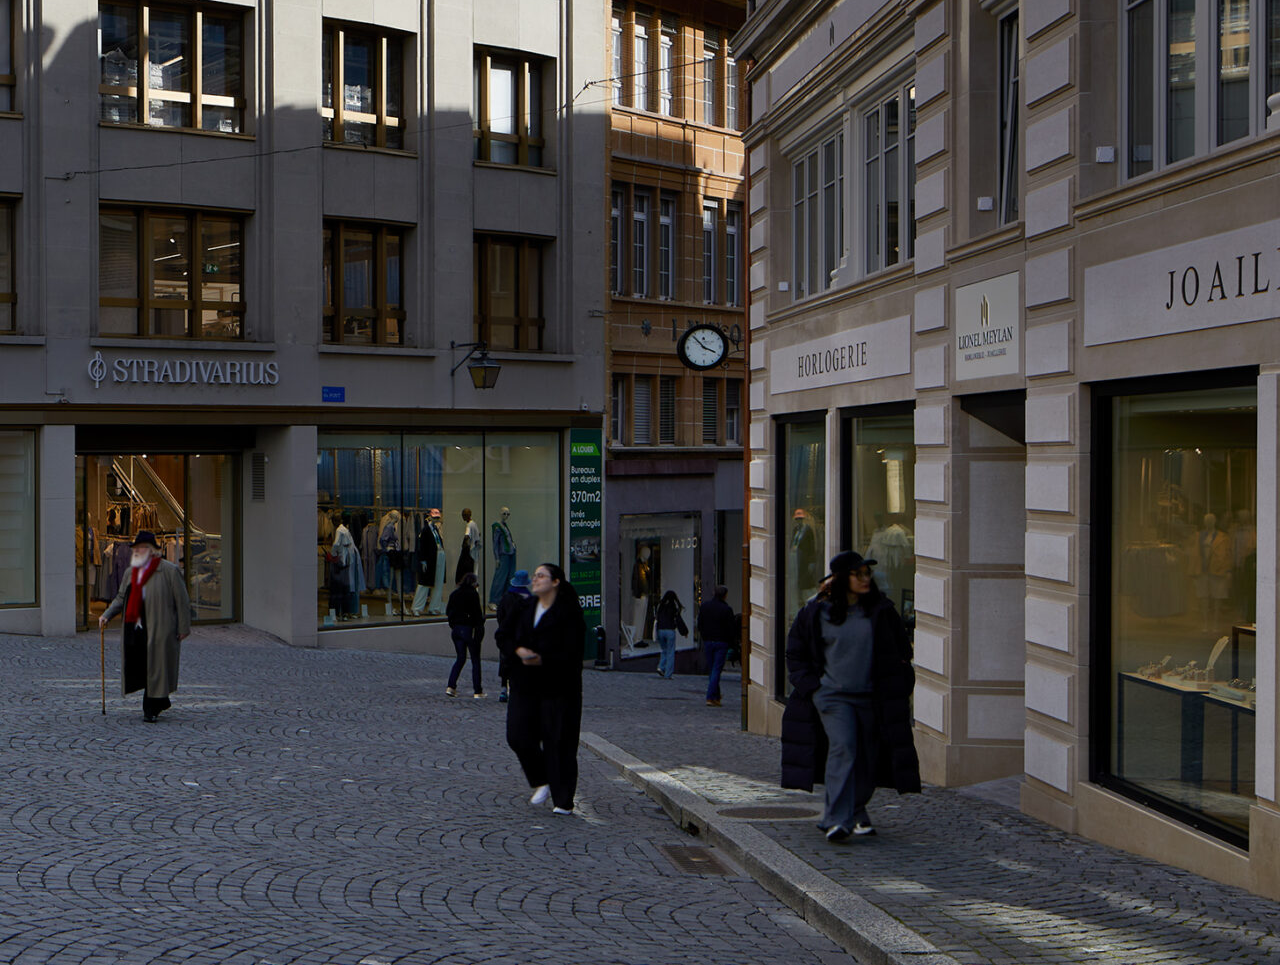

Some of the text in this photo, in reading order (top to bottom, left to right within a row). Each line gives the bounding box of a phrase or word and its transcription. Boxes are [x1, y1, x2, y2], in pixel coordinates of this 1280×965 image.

[1166, 247, 1280, 310] JOAIL
[958, 326, 1013, 350] LIONEL MEYLAN
[798, 341, 868, 378] HORLOGERIE
[112, 358, 280, 386] STRADIVARIUS
[571, 465, 596, 475] Bureaux
[571, 475, 601, 485] en duplex
[571, 489, 601, 504] 370m2
